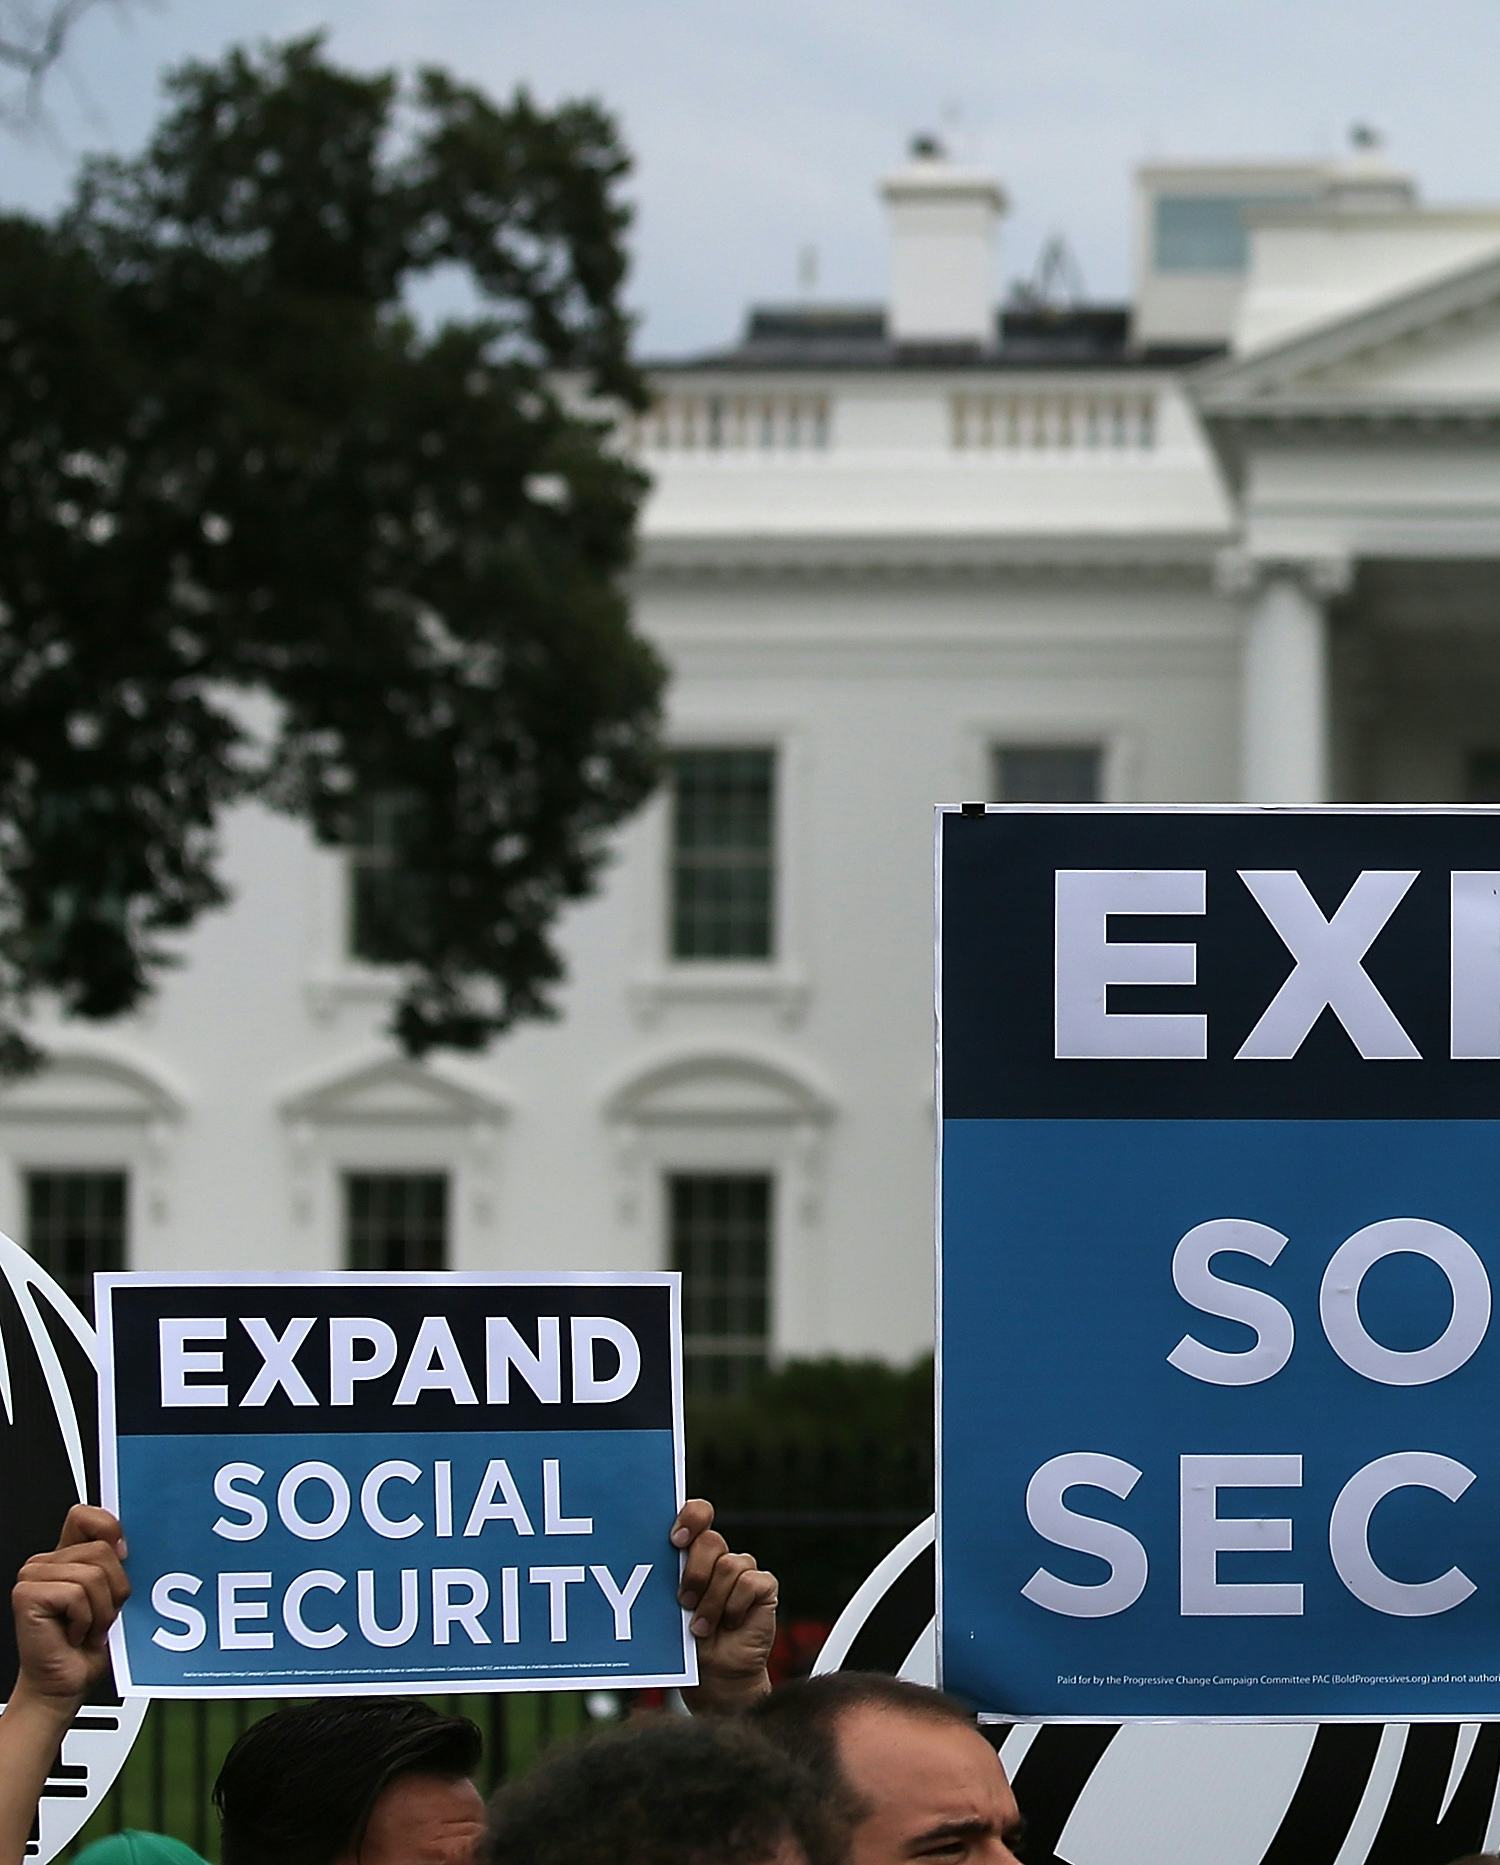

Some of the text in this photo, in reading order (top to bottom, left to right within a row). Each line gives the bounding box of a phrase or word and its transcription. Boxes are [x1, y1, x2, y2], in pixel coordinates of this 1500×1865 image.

[159, 1317, 642, 1408] EXPAND
[212, 1459, 594, 1542] SOCIAL
[151, 1564, 654, 1652] SECURITY
[1057, 1675, 1077, 1685] Paid
[1078, 1675, 1091, 1685] for
[1093, 1675, 1104, 1687] by
[1106, 1675, 1121, 1685] the
[1123, 1675, 1174, 1687] Progressive
[1175, 1675, 1211, 1687] Change
[1212, 1675, 1258, 1687] Campaign
[1260, 1674, 1310, 1685] Committee
[1312, 1674, 1330, 1684] PAC
[1331, 1674, 1430, 1686] (BoldProgressives.org)
[1432, 1673, 1450, 1683] and
[1451, 1673, 1467, 1683] not
